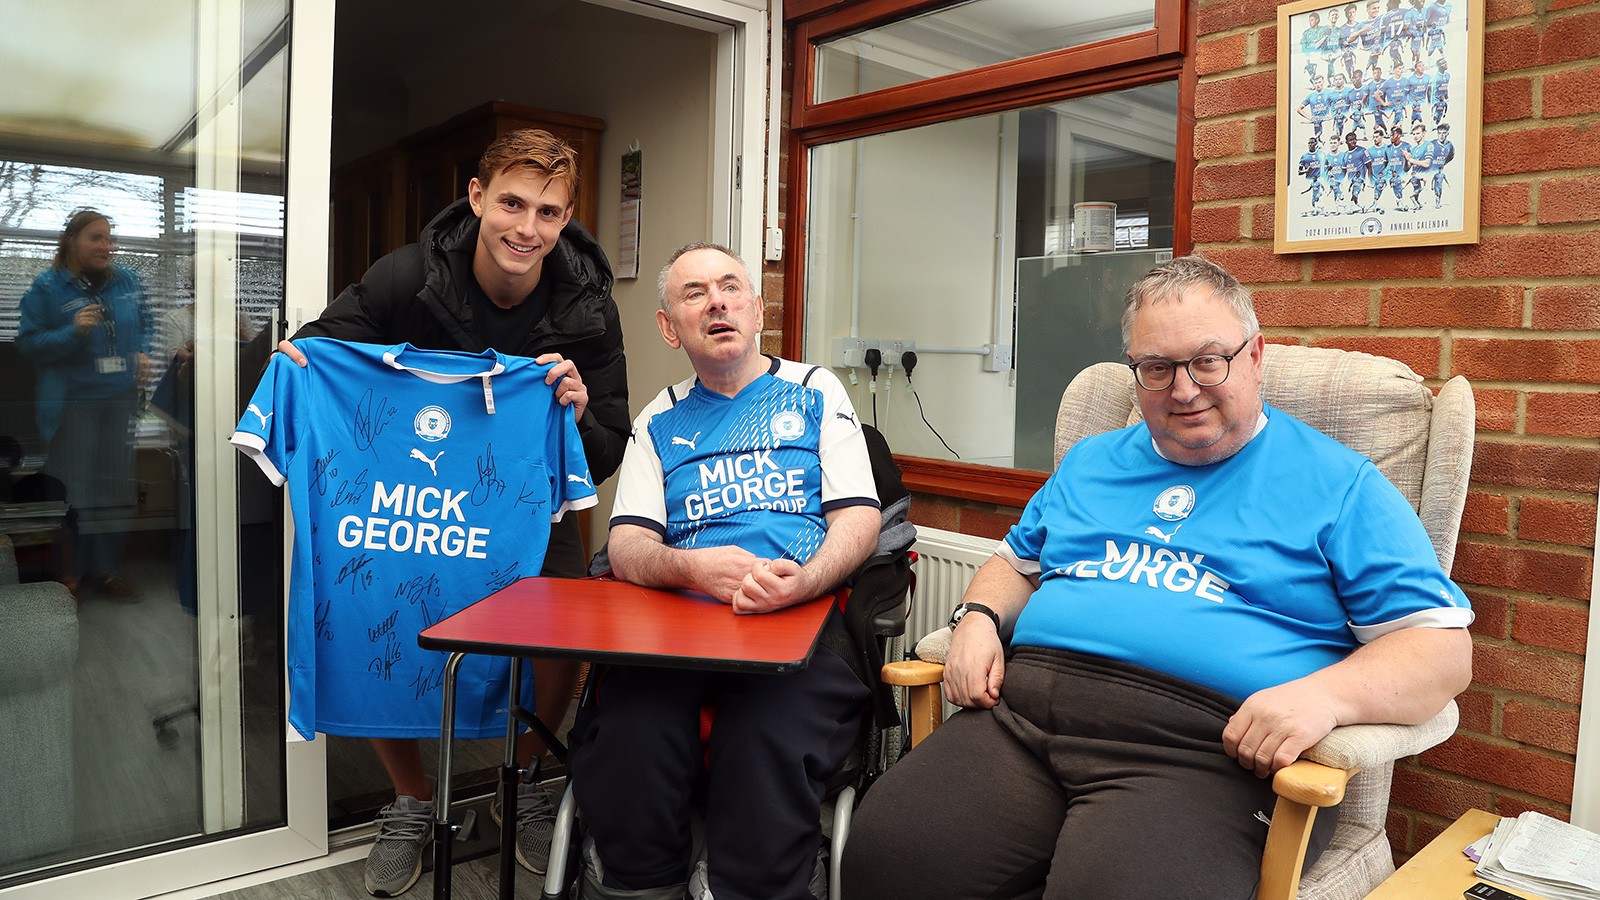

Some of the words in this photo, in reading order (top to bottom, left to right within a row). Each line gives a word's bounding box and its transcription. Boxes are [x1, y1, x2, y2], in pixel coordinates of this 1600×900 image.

[1305, 229, 1321, 237] 2024
[1324, 226, 1352, 236] OFFICIAL
[1390, 222, 1414, 231] ANNUAL
[1417, 219, 1450, 230] CALENDAR
[699, 449, 779, 490] MICK
[370, 480, 470, 523] MICK
[685, 468, 805, 521] GEORGE
[337, 514, 491, 560] GEORGE
[1054, 559, 1231, 604] EORGE
